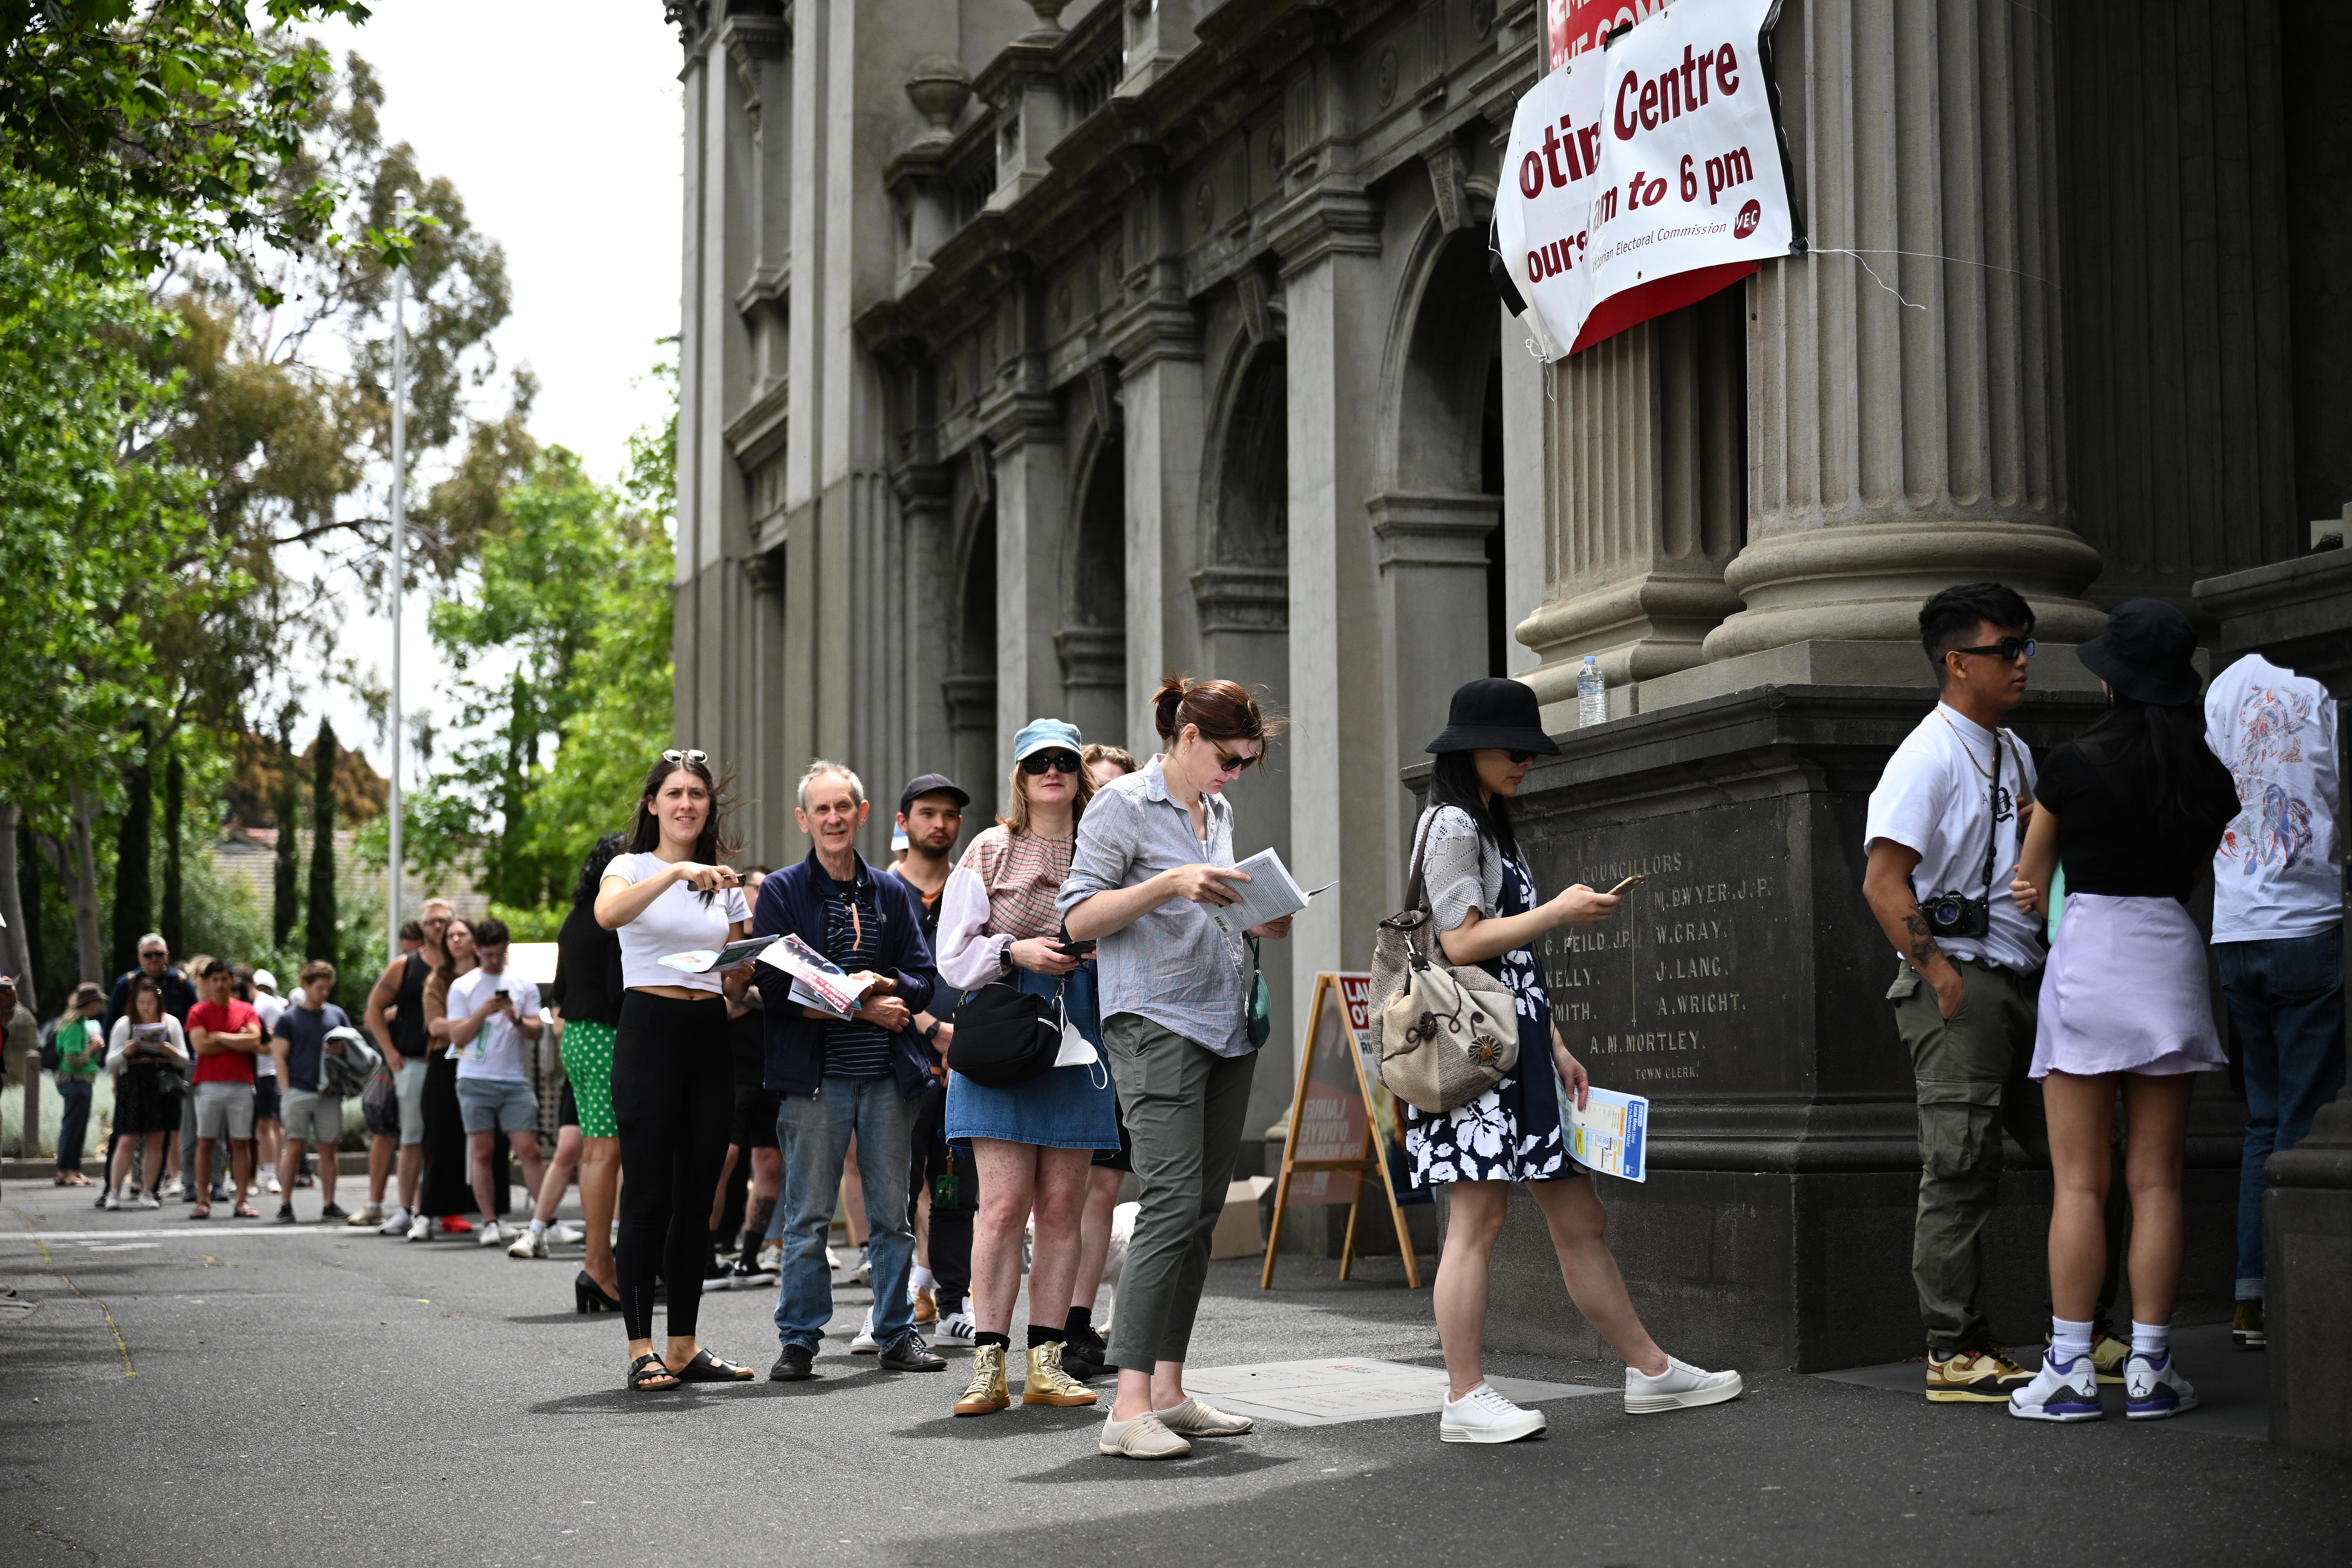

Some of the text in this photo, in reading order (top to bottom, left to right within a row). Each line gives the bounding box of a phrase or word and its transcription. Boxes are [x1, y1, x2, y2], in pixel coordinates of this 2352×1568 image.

[1614, 43, 1739, 141] Centre
[1628, 171, 1667, 211] to
[1680, 154, 1697, 202] 6
[1705, 146, 1754, 205] pm
[1735, 209, 1758, 230] VEC
[1616, 231, 1654, 256] Electoral
[1658, 222, 1727, 241] Commission
[1582, 852, 1682, 884] COUNCILLORS
[805, 977, 824, 991] doing
[825, 983, 851, 1004] matters
[827, 994, 847, 1010] Labor
[1550, 1002, 1597, 1022] MITH.
[1360, 1042, 1374, 1055] RI
[1635, 1067, 1661, 1080] TOWN
